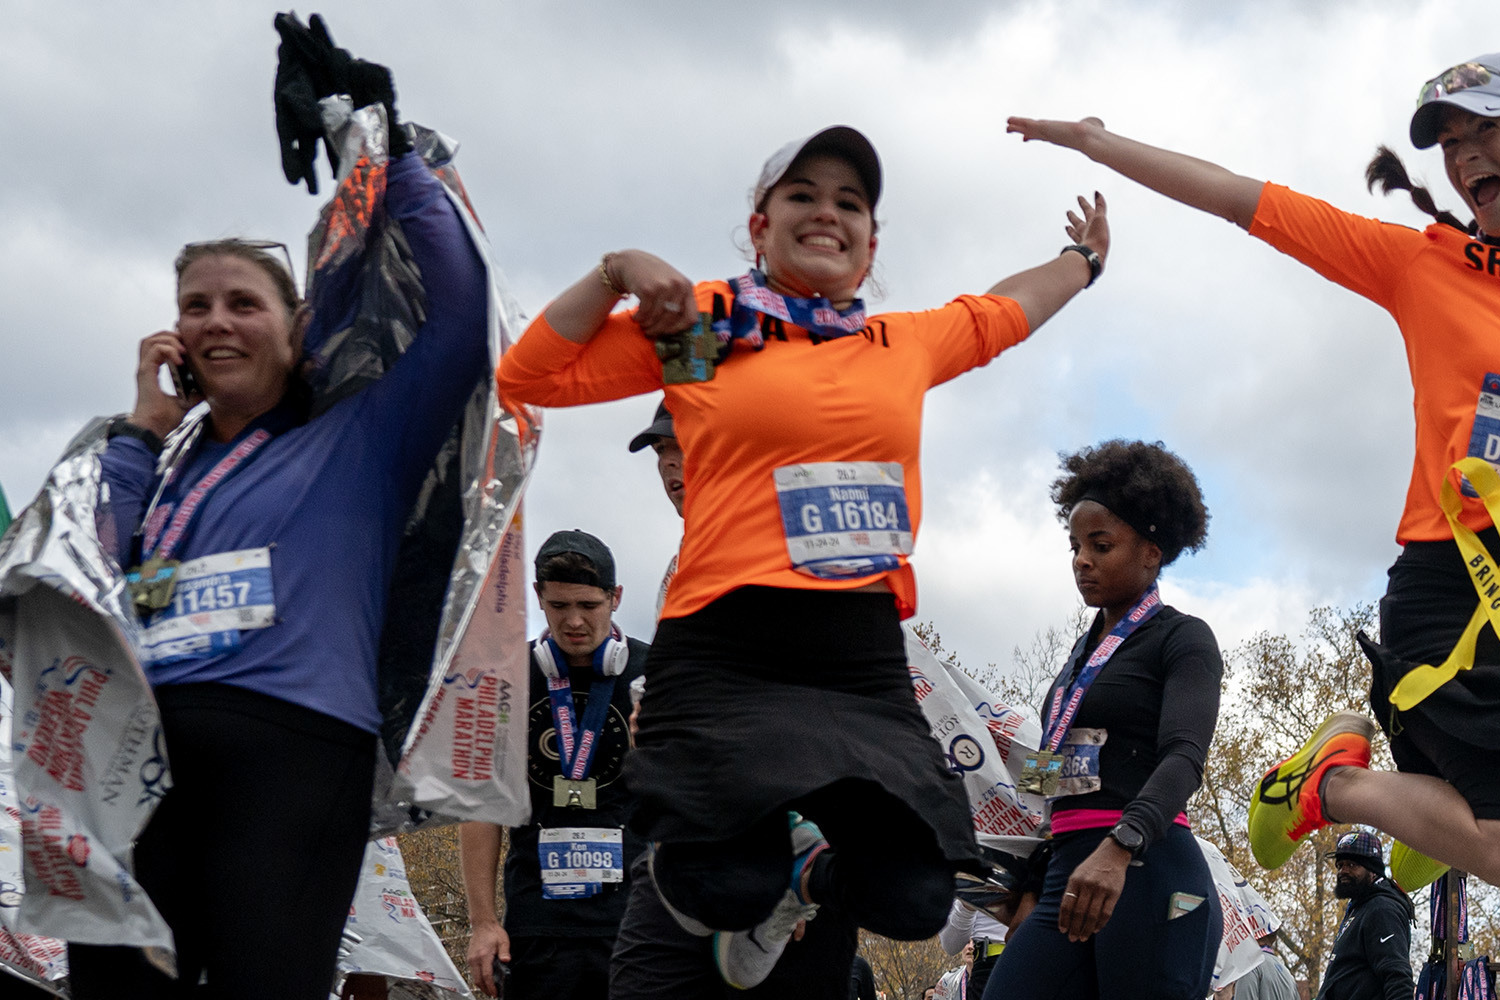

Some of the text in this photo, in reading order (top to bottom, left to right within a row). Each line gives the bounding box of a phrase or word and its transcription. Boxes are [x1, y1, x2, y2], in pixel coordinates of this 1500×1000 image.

[836, 468, 857, 481] 26.2
[829, 487, 870, 501] Naomi
[801, 501, 899, 533] G 16184
[804, 537, 840, 549] 11-24-24
[495, 531, 513, 615] Philadelphia
[1129, 605, 1147, 623] 2024
[1060, 686, 1084, 725] WEEKEND
[474, 675, 499, 781] PHILADELPHIA
[452, 697, 475, 780] MARATHON
[581, 729, 595, 746] 2024
[958, 745, 977, 760] R
[572, 832, 586, 840] 26.2
[571, 843, 587, 851] Ken
[547, 851, 613, 868] G 10098
